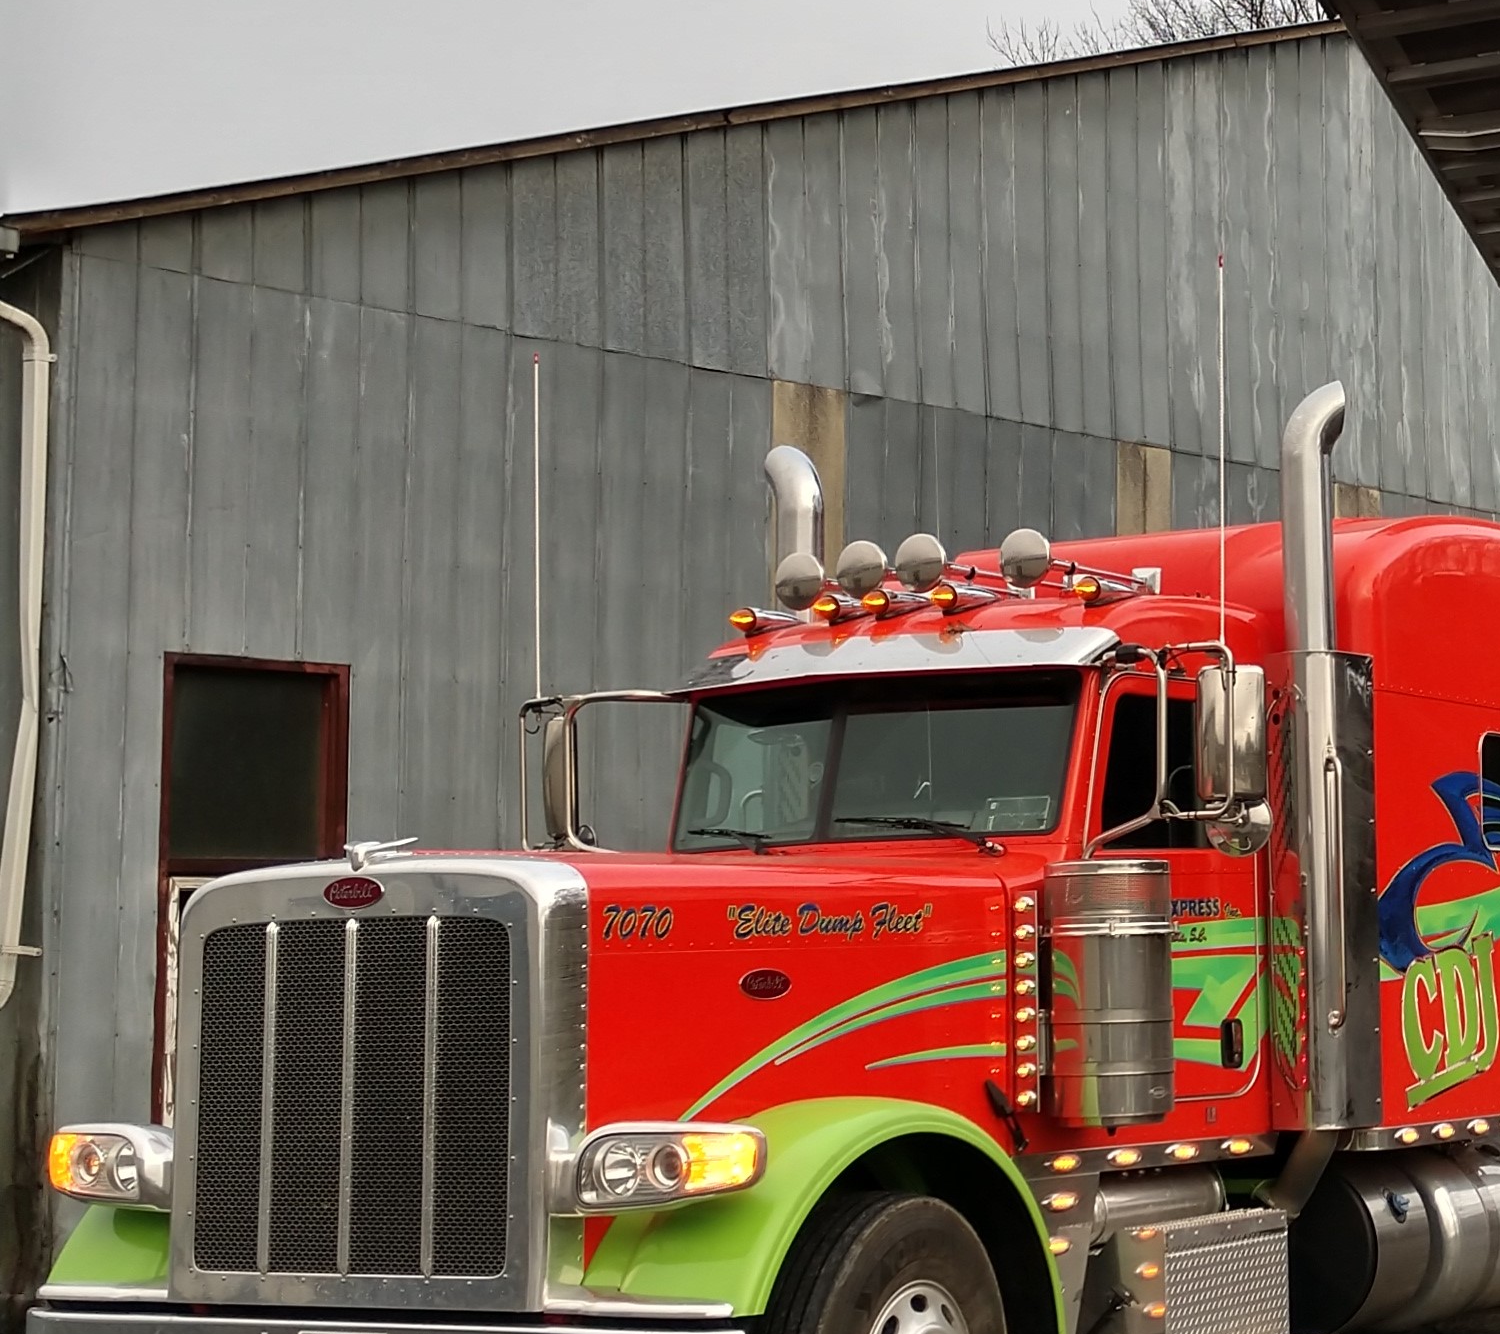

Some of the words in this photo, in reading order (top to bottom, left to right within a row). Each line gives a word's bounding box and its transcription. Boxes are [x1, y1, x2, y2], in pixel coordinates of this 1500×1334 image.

[329, 883, 377, 902] Peterbilt
[1170, 897, 1220, 918] XPRESS
[602, 903, 674, 941] 7070
[727, 902, 792, 940] "Elite
[797, 902, 865, 941] Dump
[869, 901, 933, 940] Fleet"
[1402, 931, 1500, 1085] CDJ
